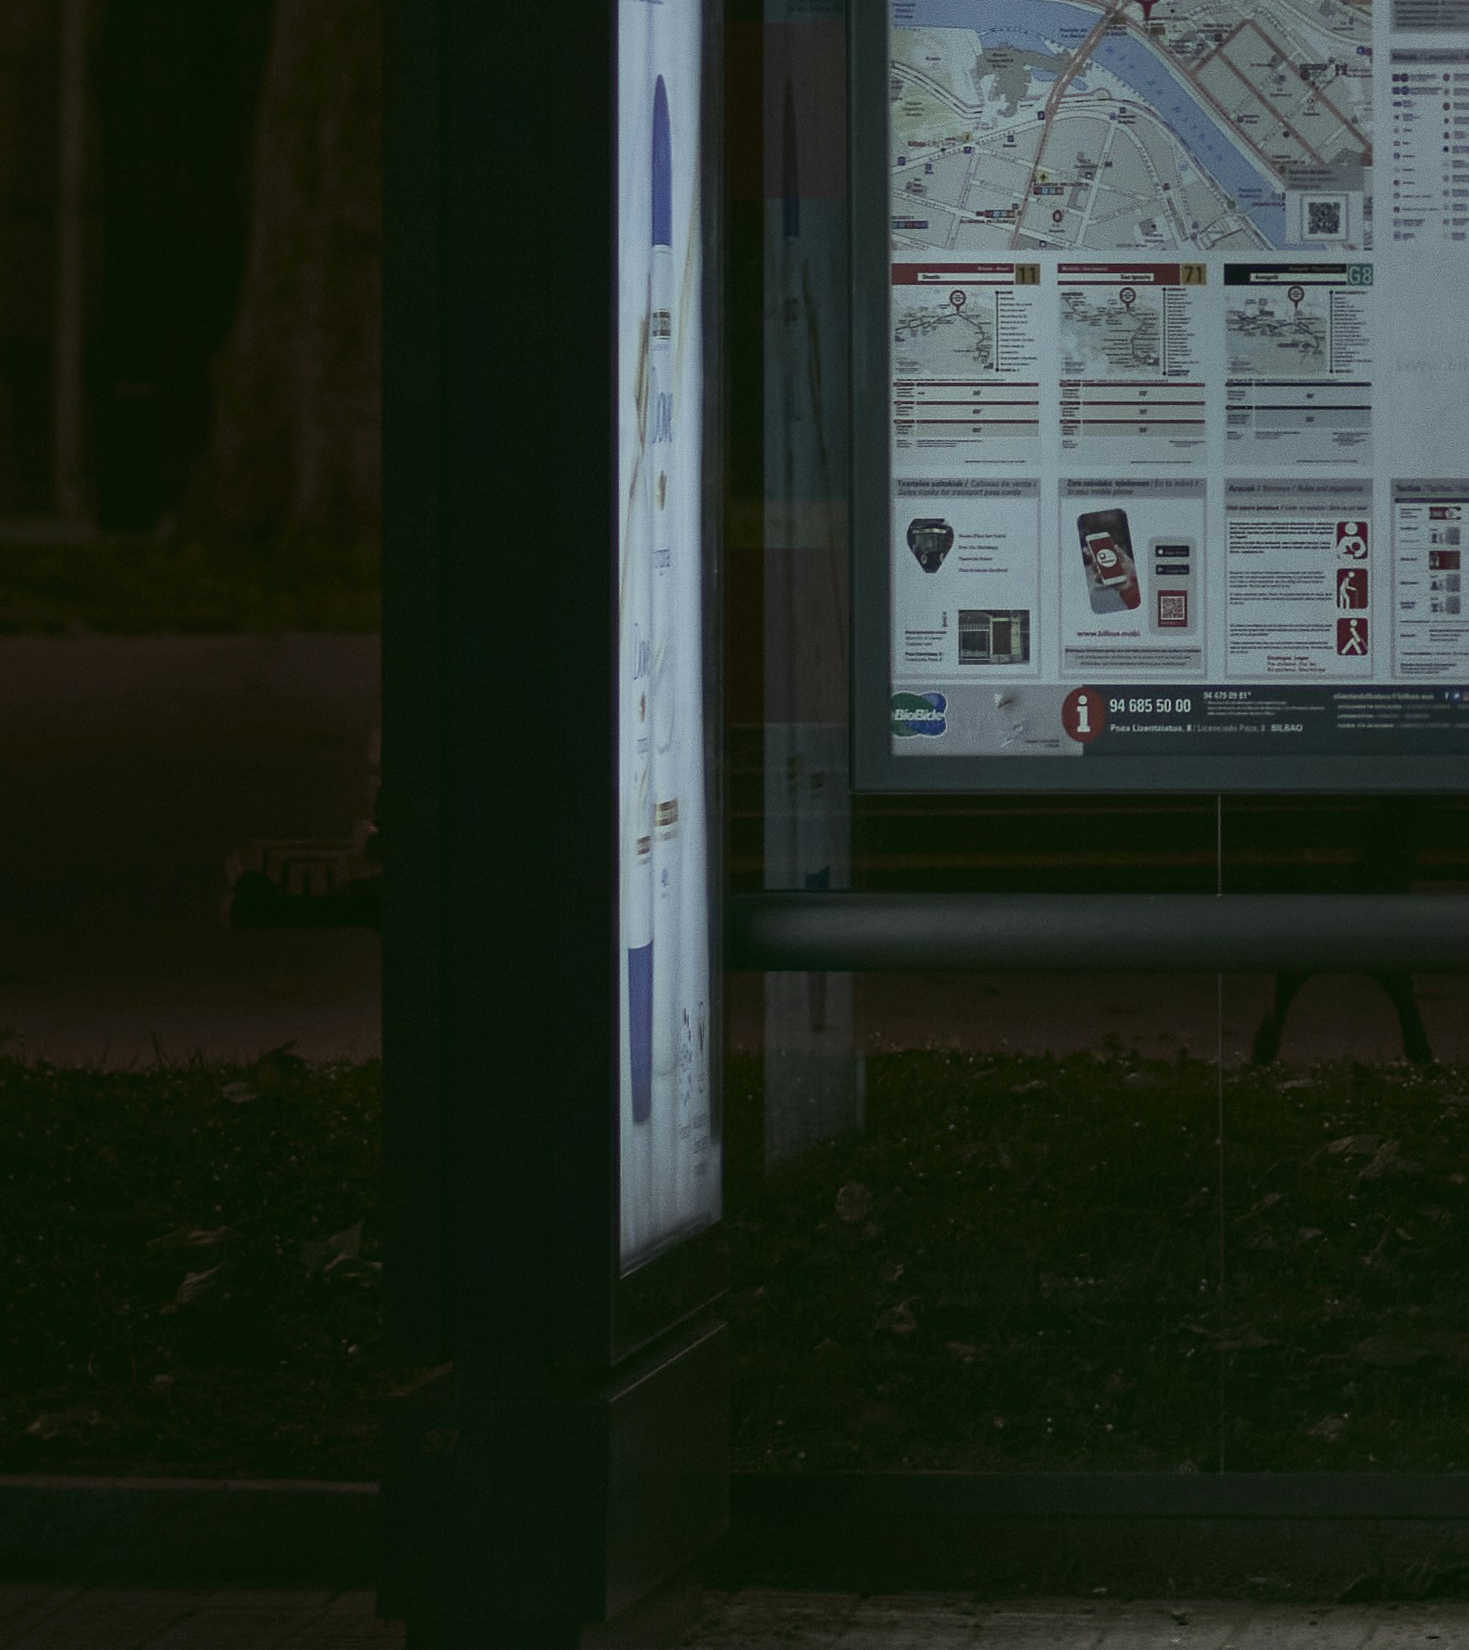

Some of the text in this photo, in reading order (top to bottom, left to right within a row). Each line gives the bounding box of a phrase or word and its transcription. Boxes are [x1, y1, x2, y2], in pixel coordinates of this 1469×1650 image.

[1019, 266, 1036, 284] 11
[1184, 265, 1203, 284] 71
[1348, 265, 1373, 285] G8
[1109, 698, 1125, 714] 94
[1128, 698, 1153, 714] 685
[1156, 698, 1172, 714] 50
[1175, 698, 1191, 714] 00
